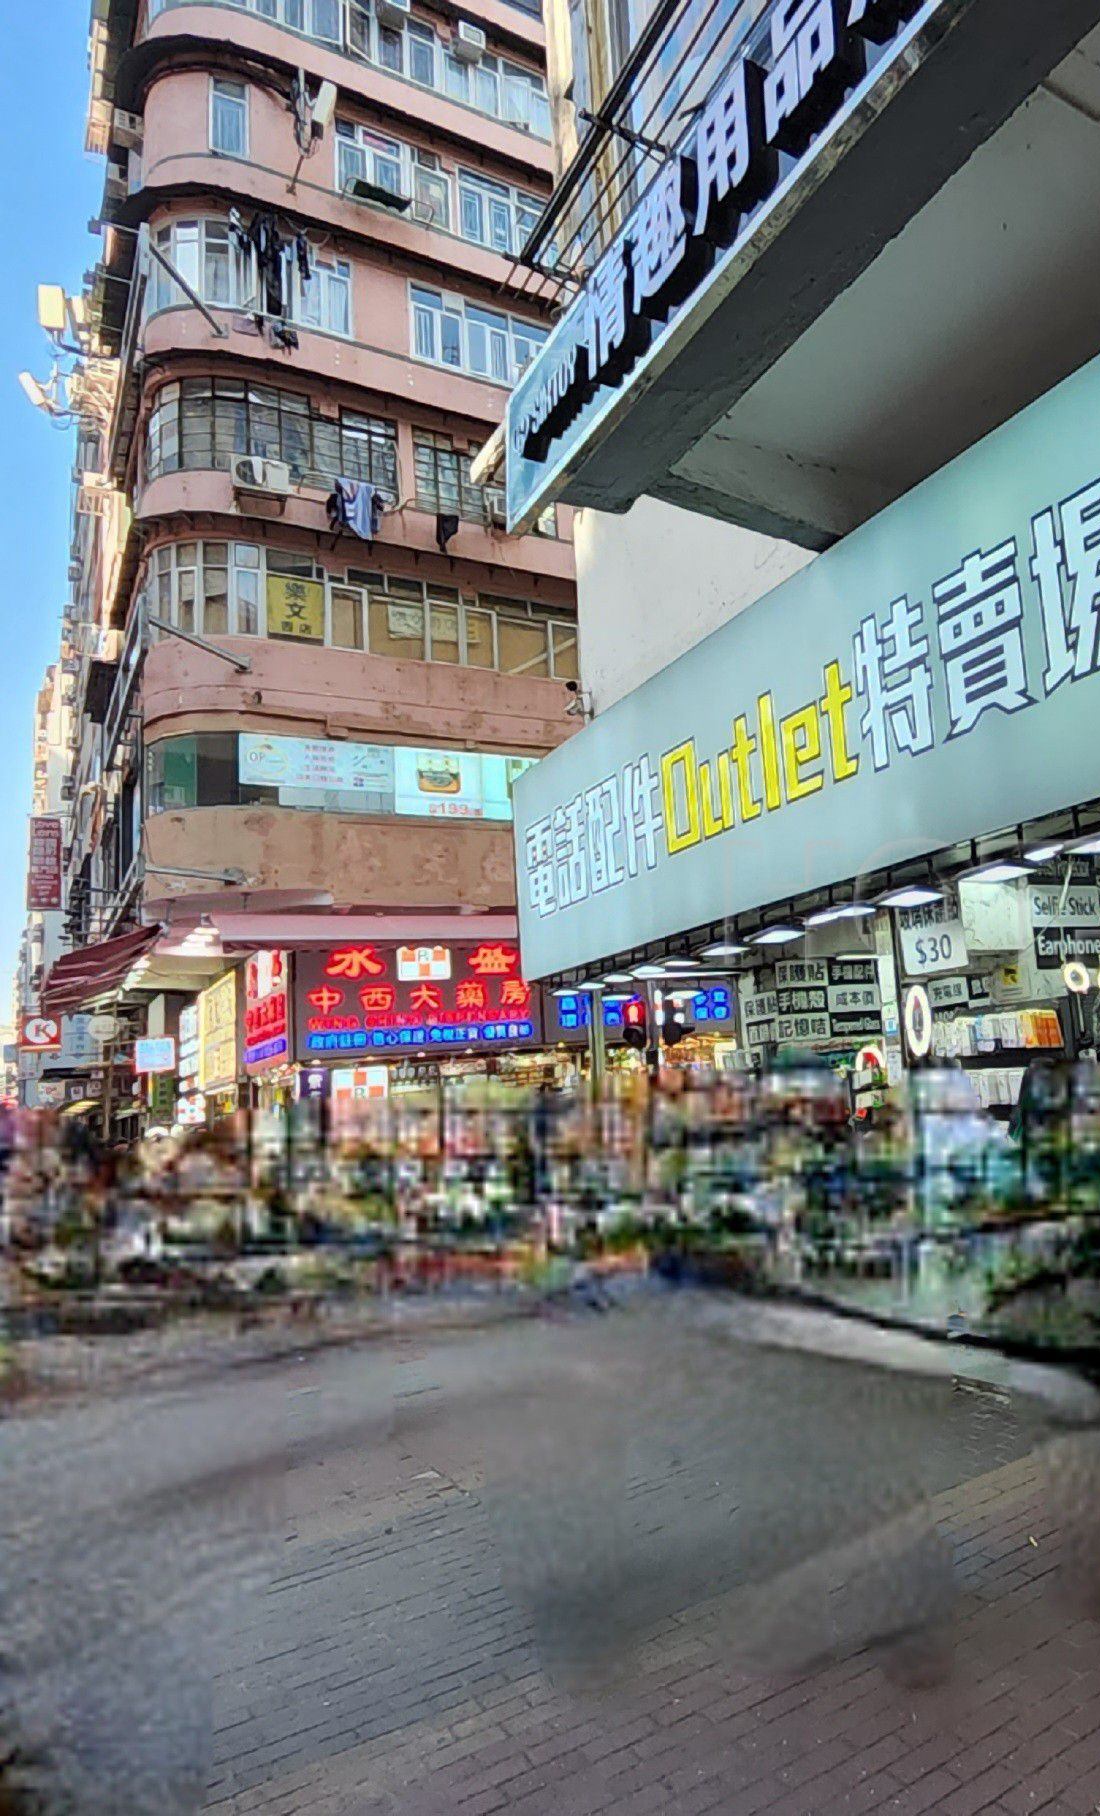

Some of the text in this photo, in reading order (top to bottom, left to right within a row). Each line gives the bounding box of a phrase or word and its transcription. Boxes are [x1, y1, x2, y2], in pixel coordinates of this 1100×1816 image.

[583, 0, 868, 381] 情趣用品
[661, 658, 859, 855] Outlet
[915, 934, 952, 968] $30
